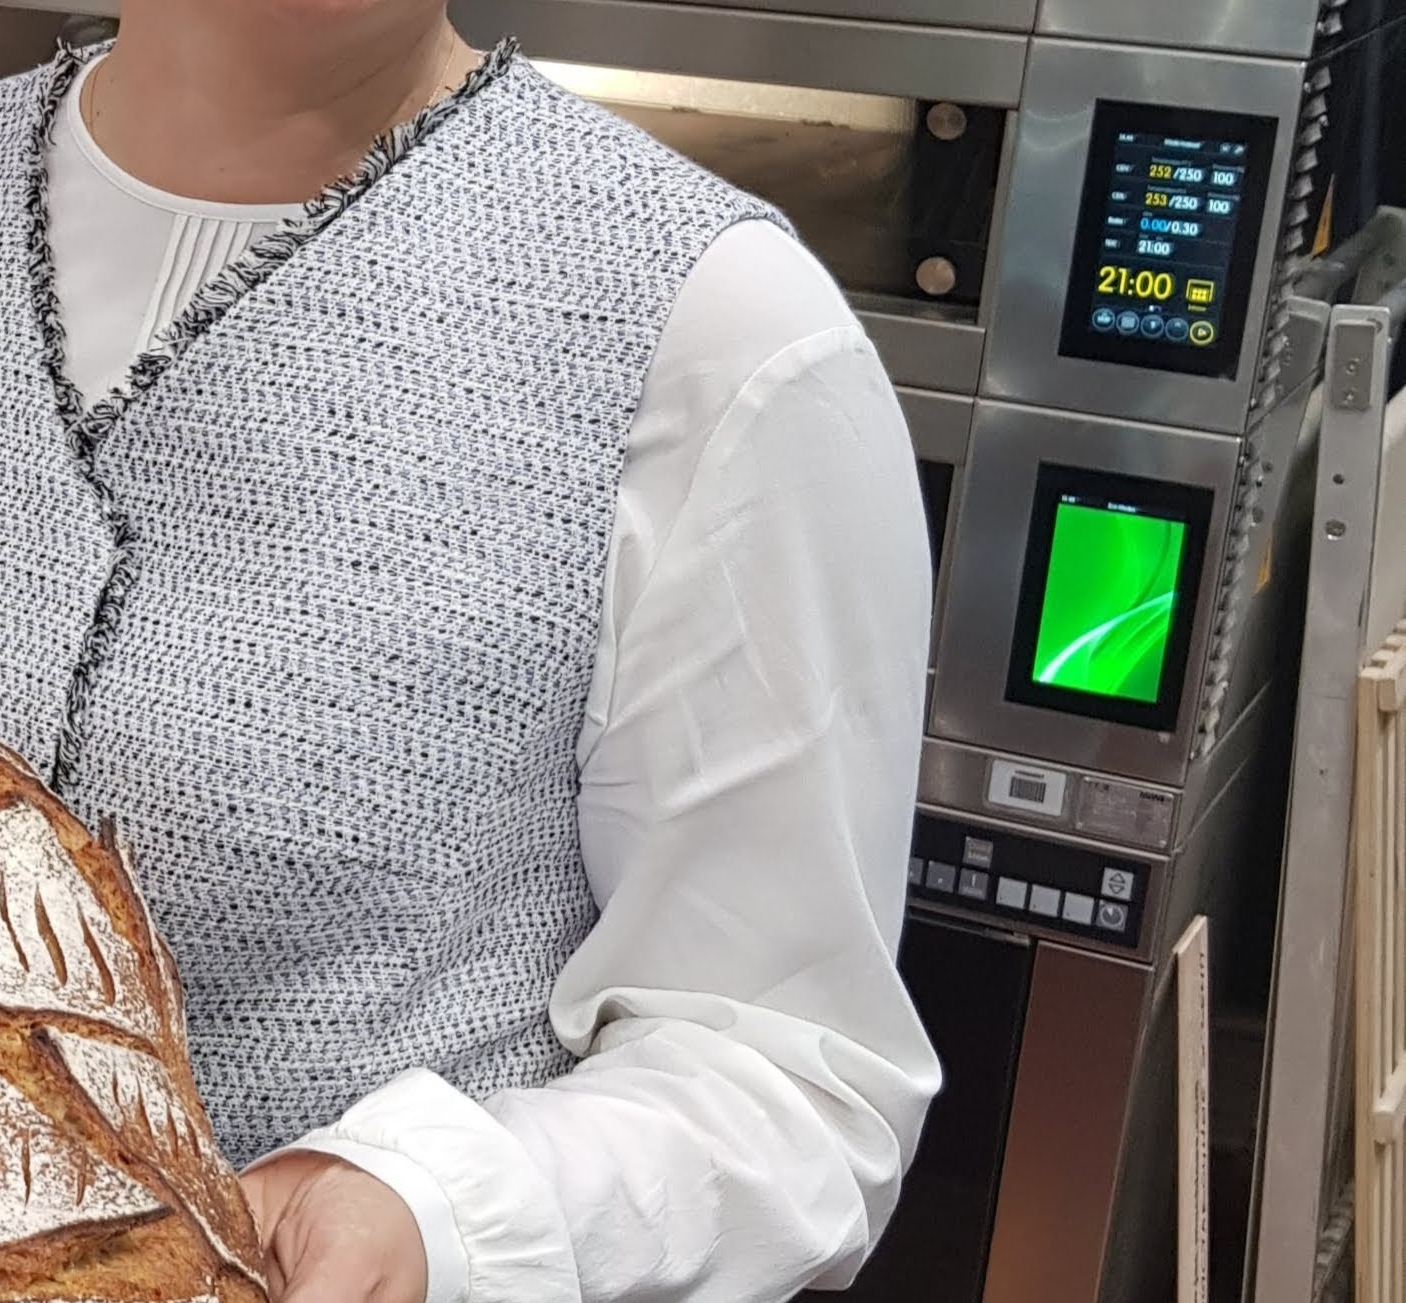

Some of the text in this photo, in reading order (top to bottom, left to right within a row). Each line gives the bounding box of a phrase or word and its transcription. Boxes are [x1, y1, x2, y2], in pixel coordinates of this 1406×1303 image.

[1213, 170, 1235, 186] 100
[1208, 198, 1230, 214] 100
[1097, 265, 1173, 300] 21:00
